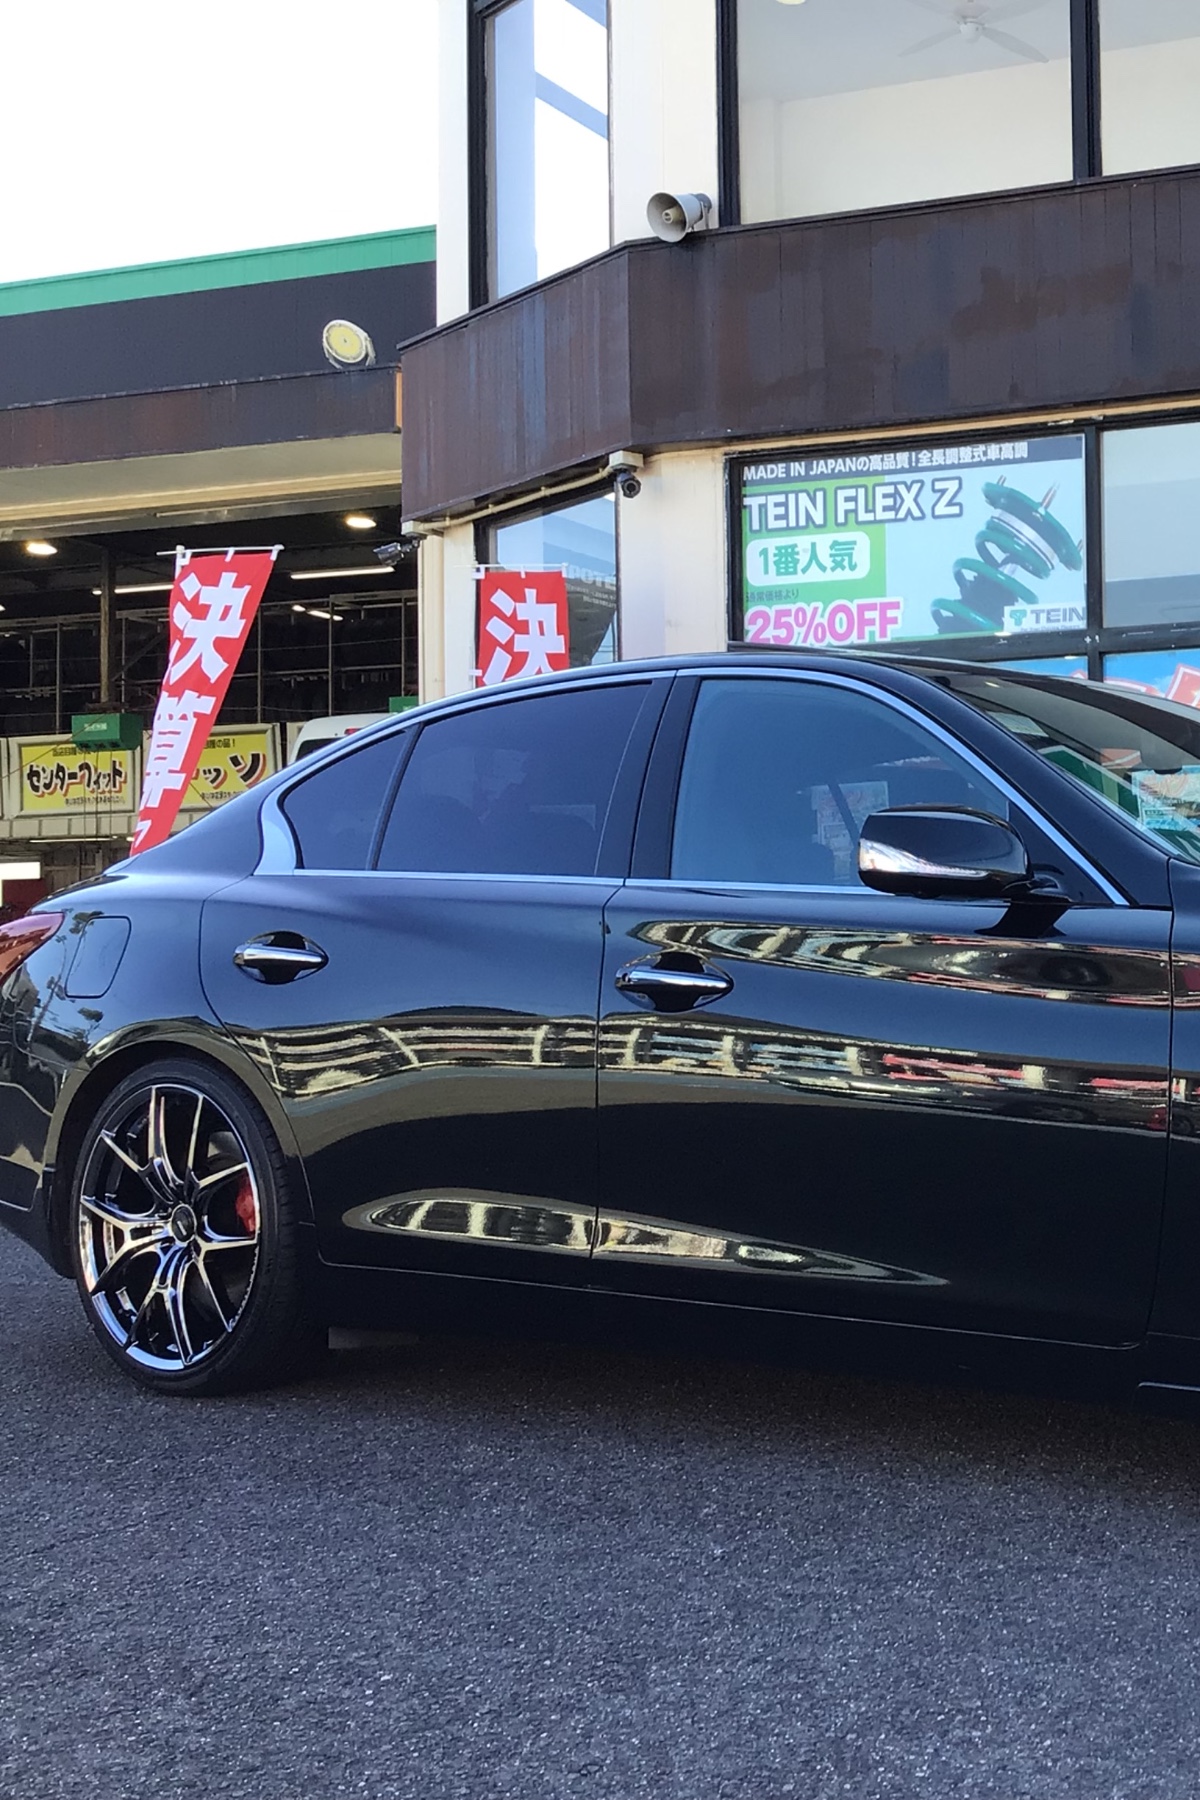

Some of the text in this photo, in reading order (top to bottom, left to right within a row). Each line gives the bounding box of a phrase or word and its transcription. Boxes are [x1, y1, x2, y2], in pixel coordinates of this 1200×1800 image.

[743, 463, 786, 481] MADE
[790, 461, 805, 477] IN
[742, 479, 961, 531] TEIN FLEX Z
[759, 540, 858, 577] 1番人気
[483, 588, 565, 686] 決
[747, 601, 901, 644] 25%OFF
[1030, 607, 1086, 624] TEIN
[135, 572, 251, 848] 決算
